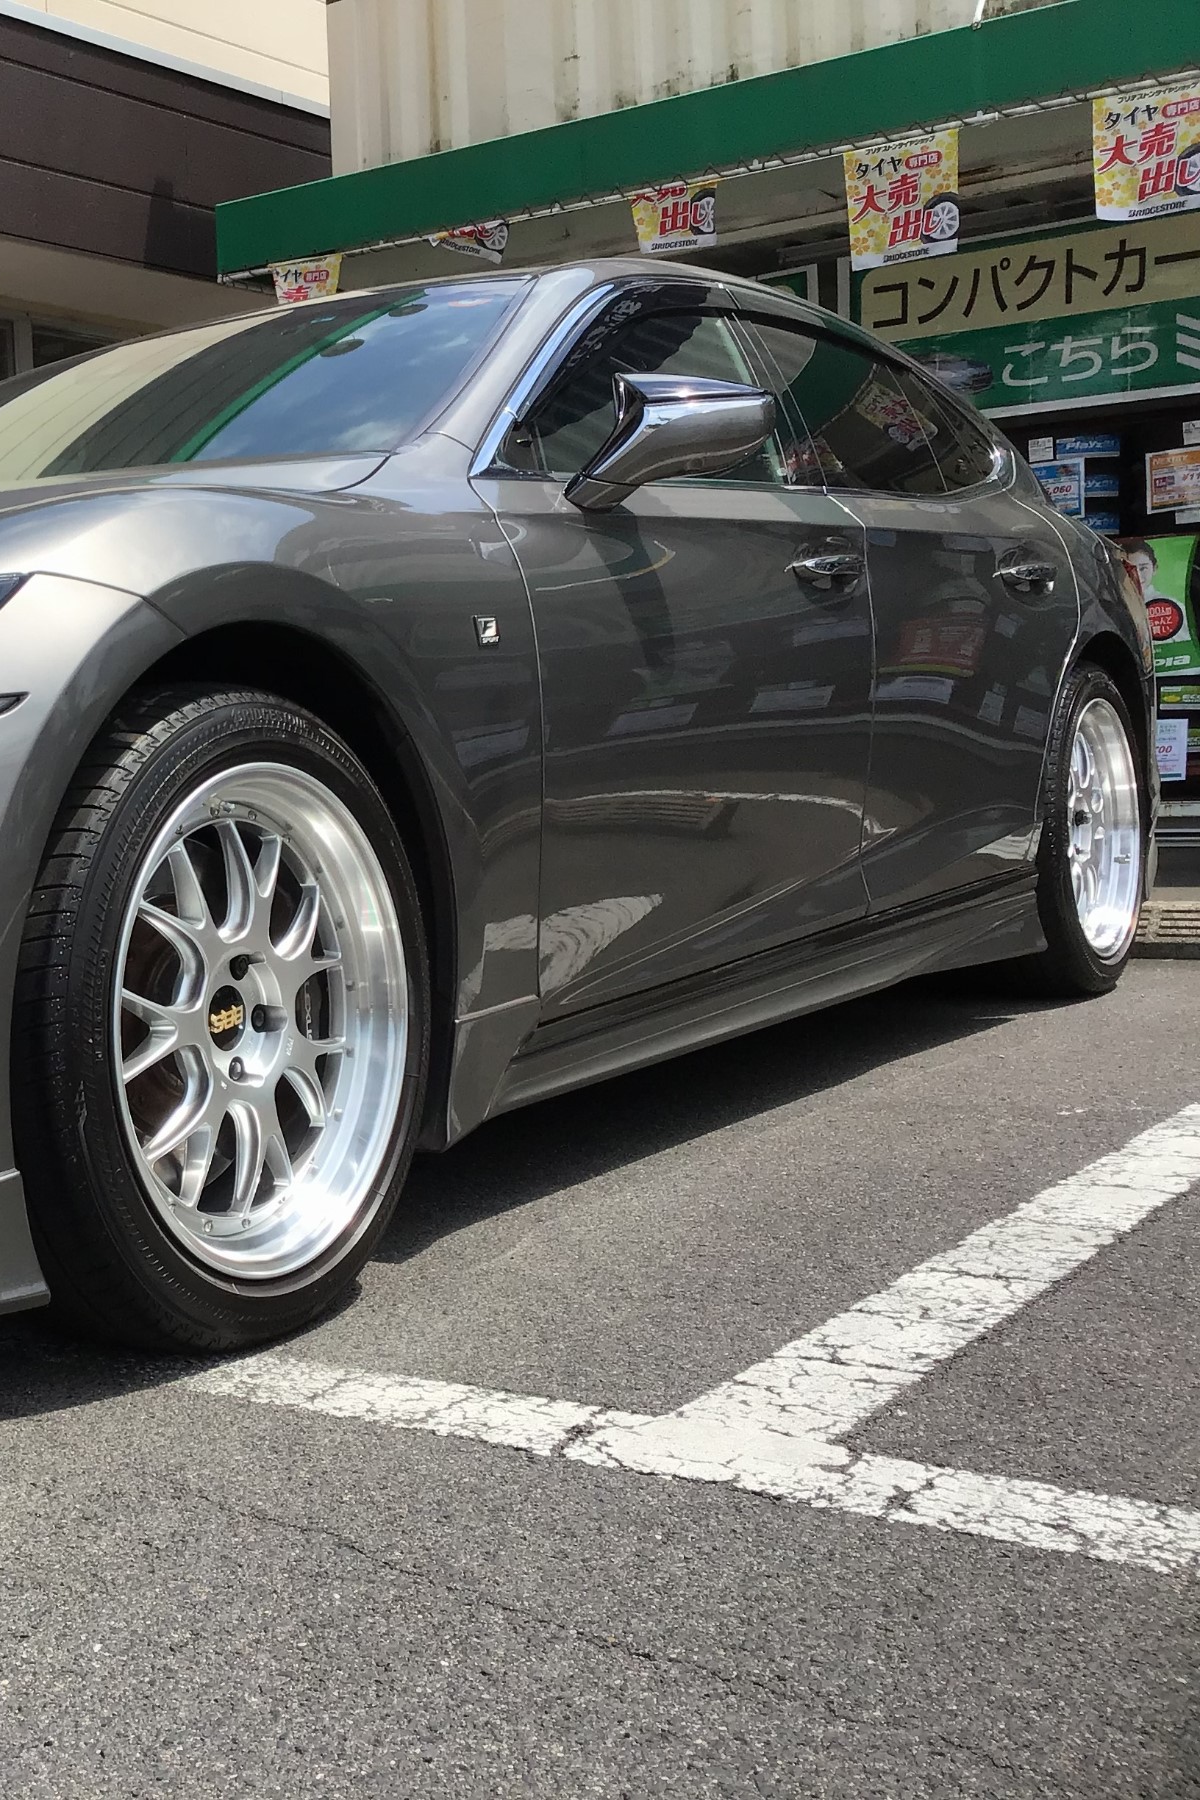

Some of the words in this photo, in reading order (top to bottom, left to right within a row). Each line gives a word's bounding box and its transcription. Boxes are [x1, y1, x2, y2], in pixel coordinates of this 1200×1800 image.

[1104, 105, 1158, 130] タイヤ
[855, 156, 903, 180] タイヤ
[1128, 200, 1188, 218] BRIDGESTONE
[651, 239, 699, 251] BRIDGESTONE
[883, 247, 930, 263] BRIDGESTONE
[274, 268, 302, 283] イヤ
[872, 238, 1200, 330] コンパクトカー
[1002, 326, 1159, 387] こちら
[210, 1004, 244, 1034] BBS
